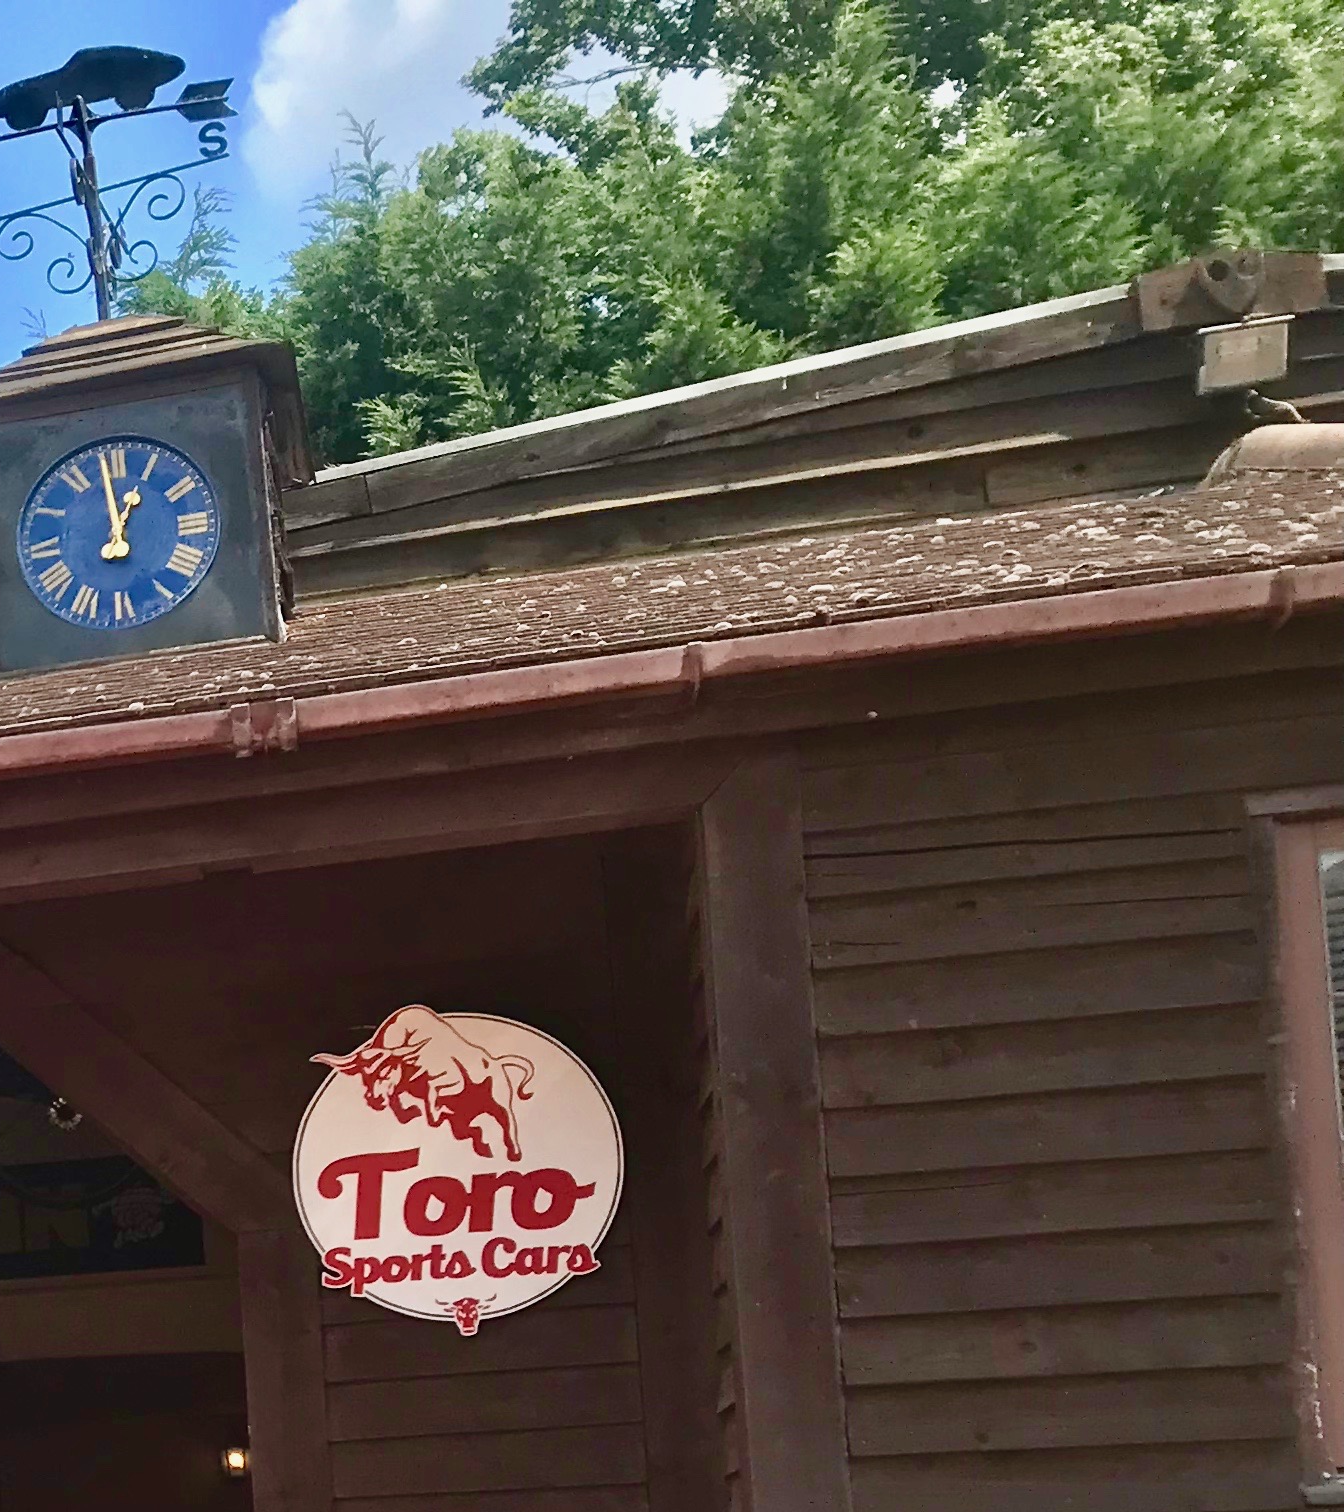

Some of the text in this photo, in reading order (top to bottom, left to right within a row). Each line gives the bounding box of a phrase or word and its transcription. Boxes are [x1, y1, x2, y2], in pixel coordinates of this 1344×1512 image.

[198, 121, 228, 158] S
[317, 1147, 597, 1241] Toro
[323, 1237, 598, 1295] Sports Cars
